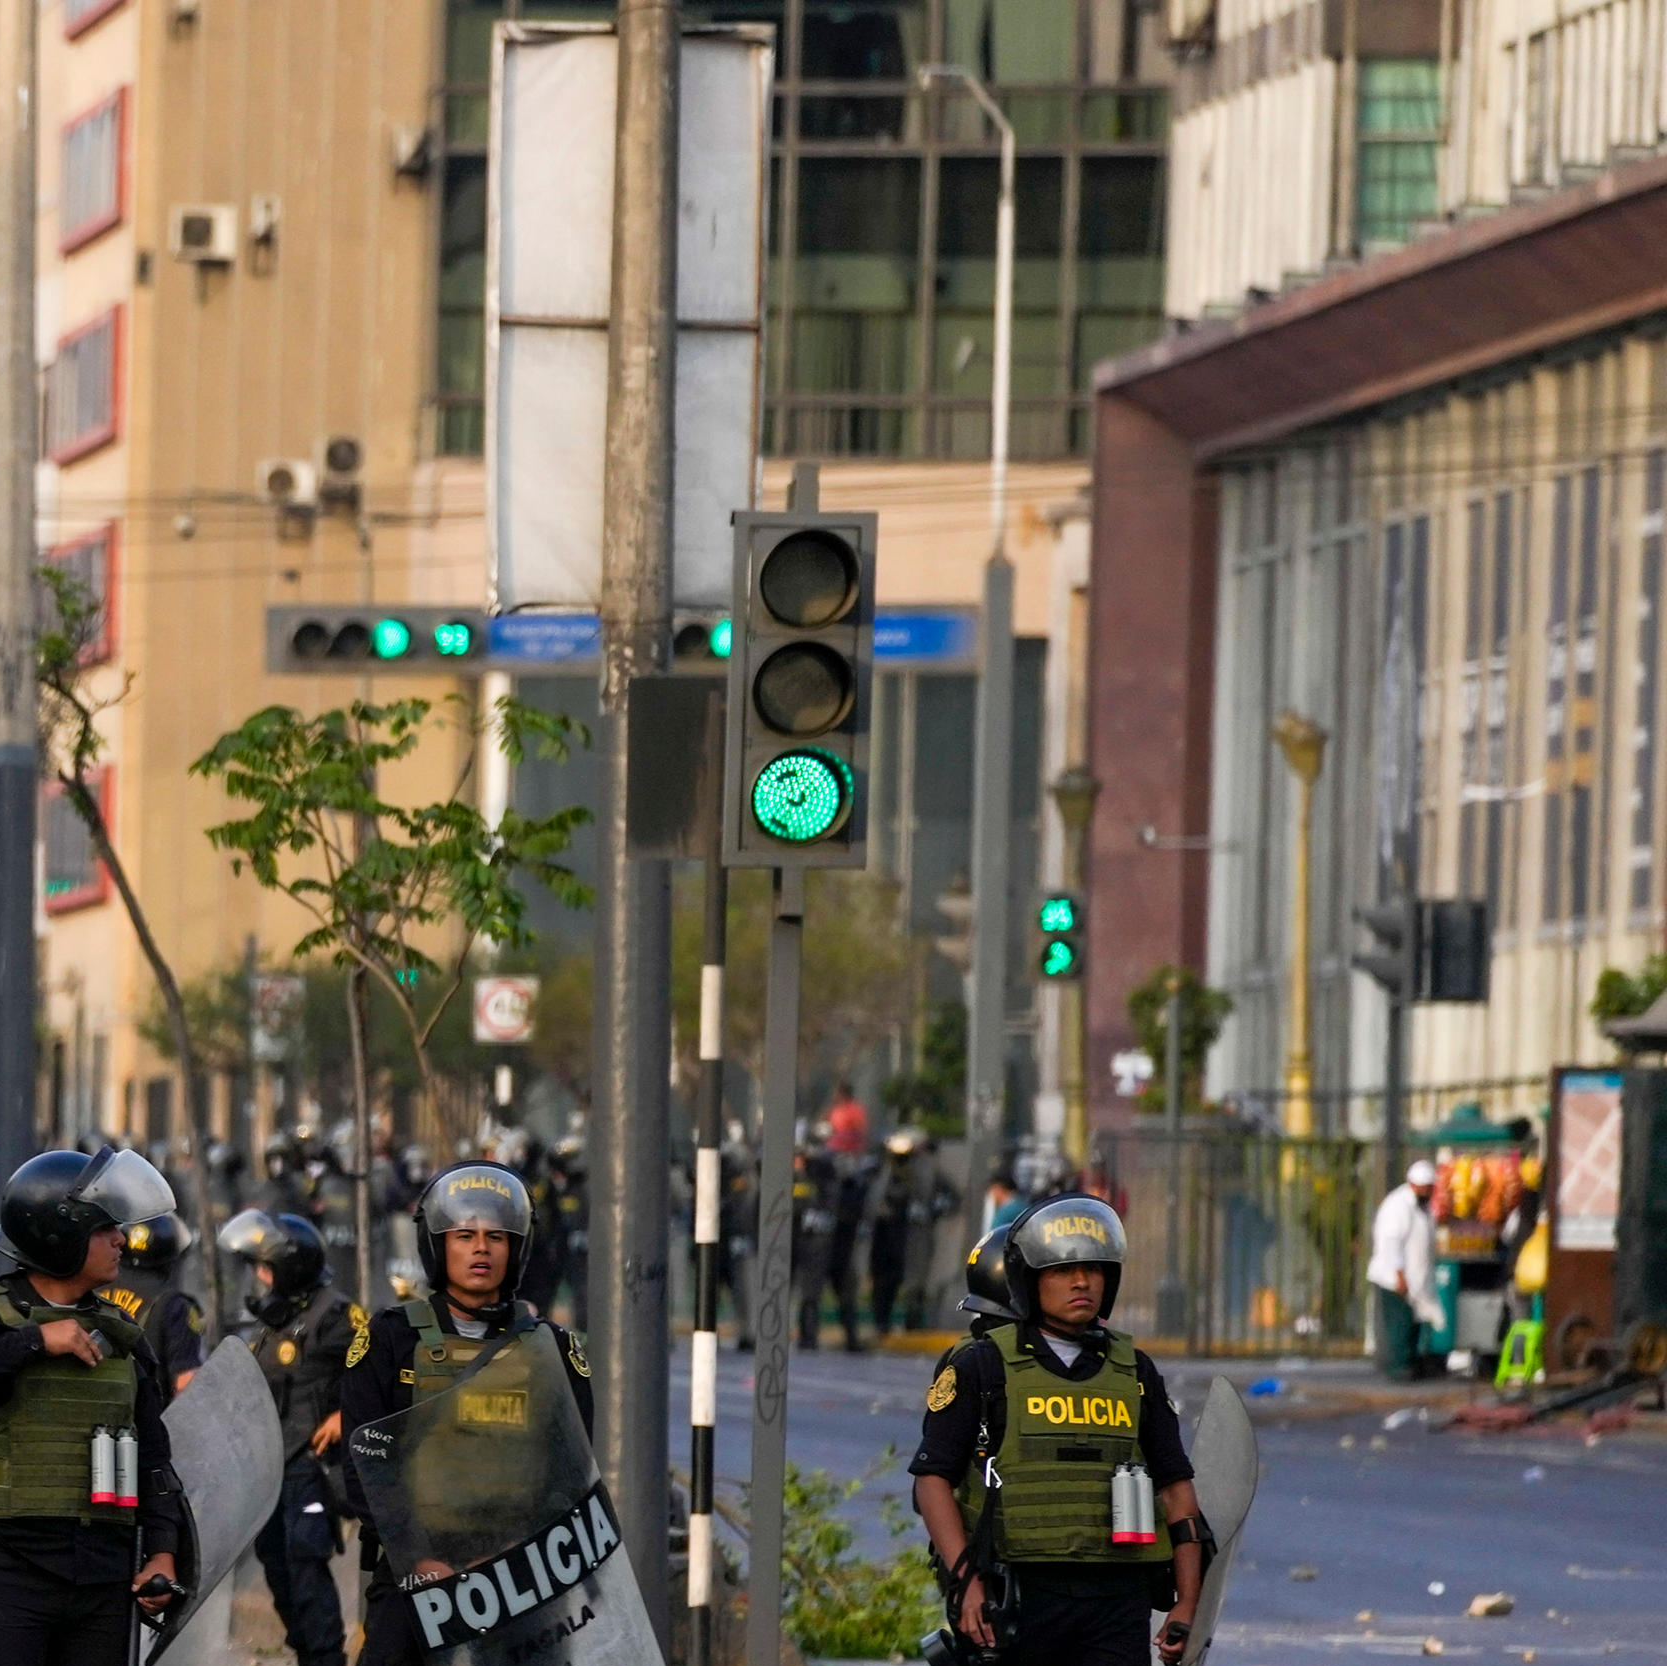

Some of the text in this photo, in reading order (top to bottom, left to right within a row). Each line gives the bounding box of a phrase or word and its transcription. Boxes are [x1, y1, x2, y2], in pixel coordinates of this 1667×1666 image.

[448, 1174, 511, 1199] POLICIA
[1043, 1216, 1107, 1246] POLICIA
[411, 1494, 619, 1649] POLICIA
